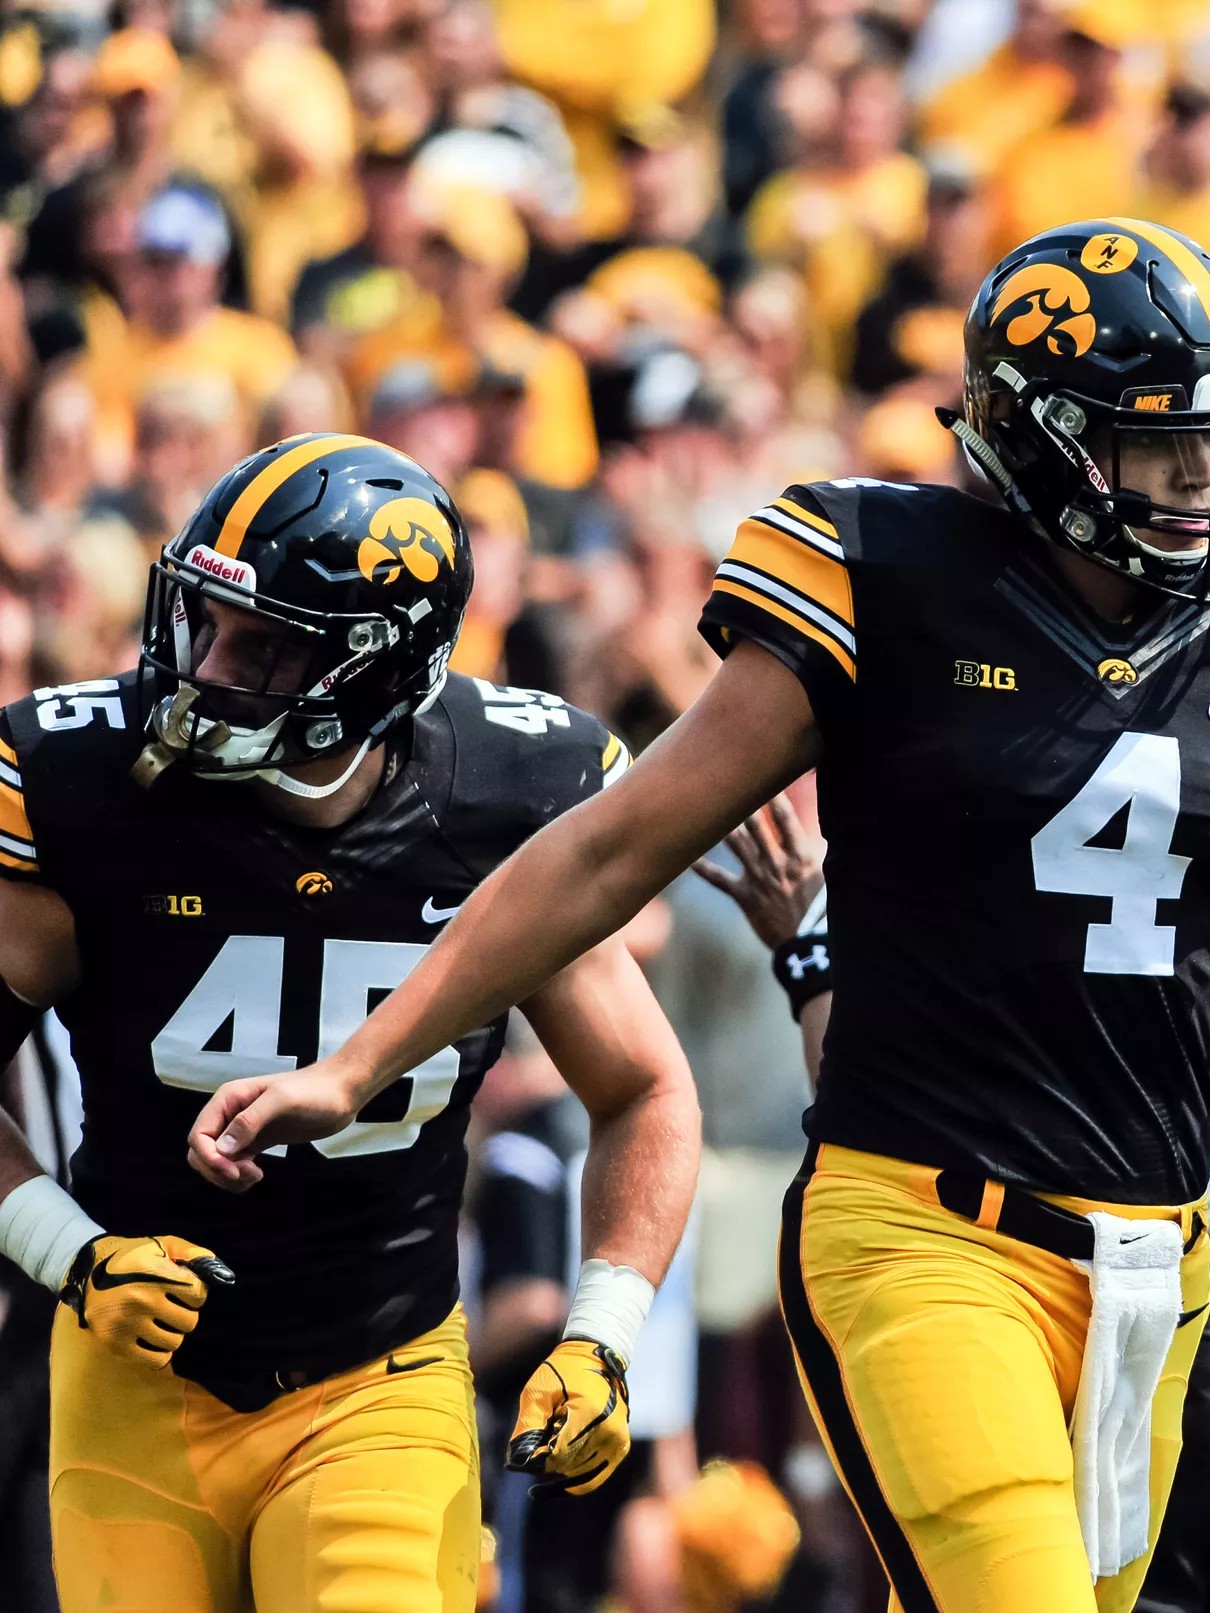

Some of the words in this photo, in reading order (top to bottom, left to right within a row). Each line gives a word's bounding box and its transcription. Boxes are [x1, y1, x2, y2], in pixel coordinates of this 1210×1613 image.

[1134, 394, 1173, 411] NIKE
[191, 550, 246, 583] Riddell
[1032, 731, 1192, 976] 4
[152, 935, 459, 1159] 45
